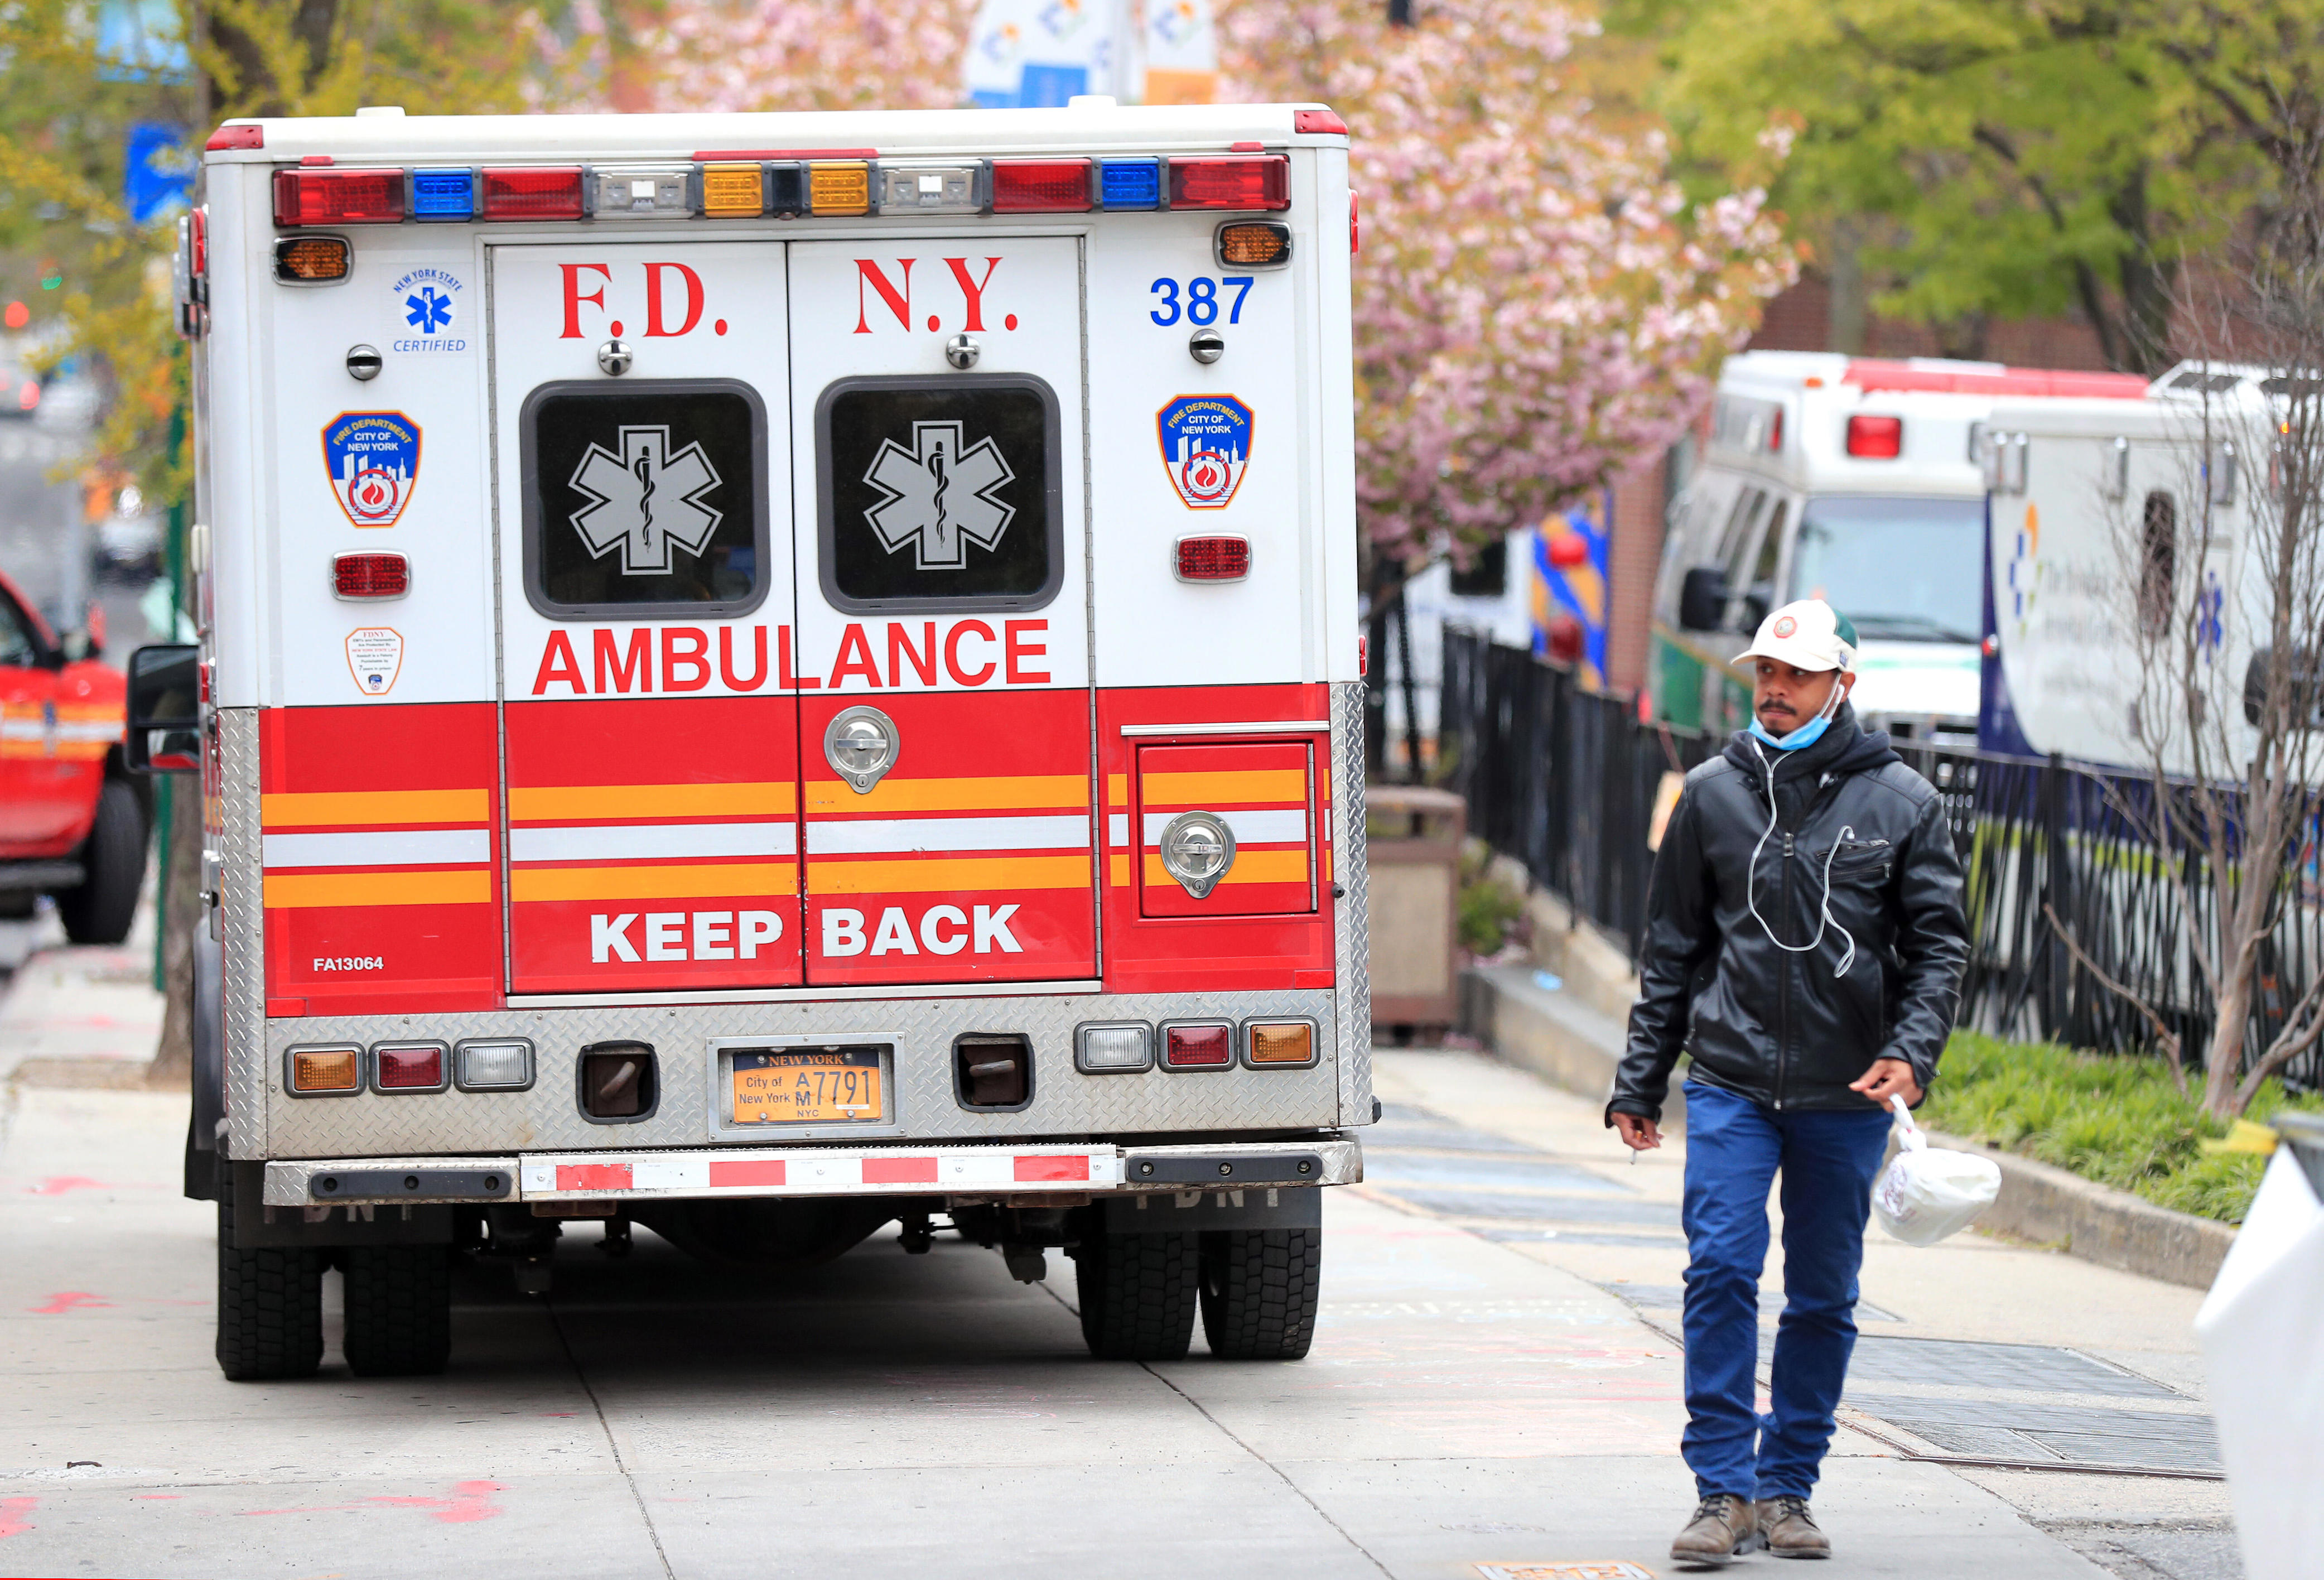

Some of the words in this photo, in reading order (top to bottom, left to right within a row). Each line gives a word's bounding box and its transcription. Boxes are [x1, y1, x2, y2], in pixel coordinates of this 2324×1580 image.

[393, 274, 412, 293] NEW
[412, 269, 437, 279] YORK
[438, 271, 464, 292] STATE
[558, 263, 728, 339] F.D.
[854, 257, 1018, 334] N.Y.
[1150, 276, 1254, 326] 387
[393, 339, 466, 352] CERTIFIED
[1168, 409, 1187, 428] FIRE
[1185, 402, 1245, 427] DEPARTMENT
[1188, 415, 1210, 424] CITY
[1211, 415, 1224, 423] OF
[332, 426, 353, 446] FIRE
[351, 418, 413, 444] DEPARTMENT
[354, 432, 377, 441] CITY
[377, 432, 392, 441] OF
[1182, 426, 1204, 434] NEW
[1204, 426, 1231, 434] YORK
[347, 443, 370, 452] NEW
[371, 442, 399, 451] YORK
[532, 619, 1051, 695] AMBULANCE
[590, 910, 784, 964] KEEP
[822, 904, 1024, 957] BACK
[313, 956, 384, 972] FA13064
[769, 1056, 803, 1067] NEW
[806, 1054, 845, 1065] YORK
[746, 1076, 768, 1090] City
[772, 1076, 783, 1087] of
[813, 1071, 870, 1106] 7791
[740, 1094, 763, 1104] New
[766, 1093, 791, 1104] York
[797, 1109, 819, 1117] NYC
